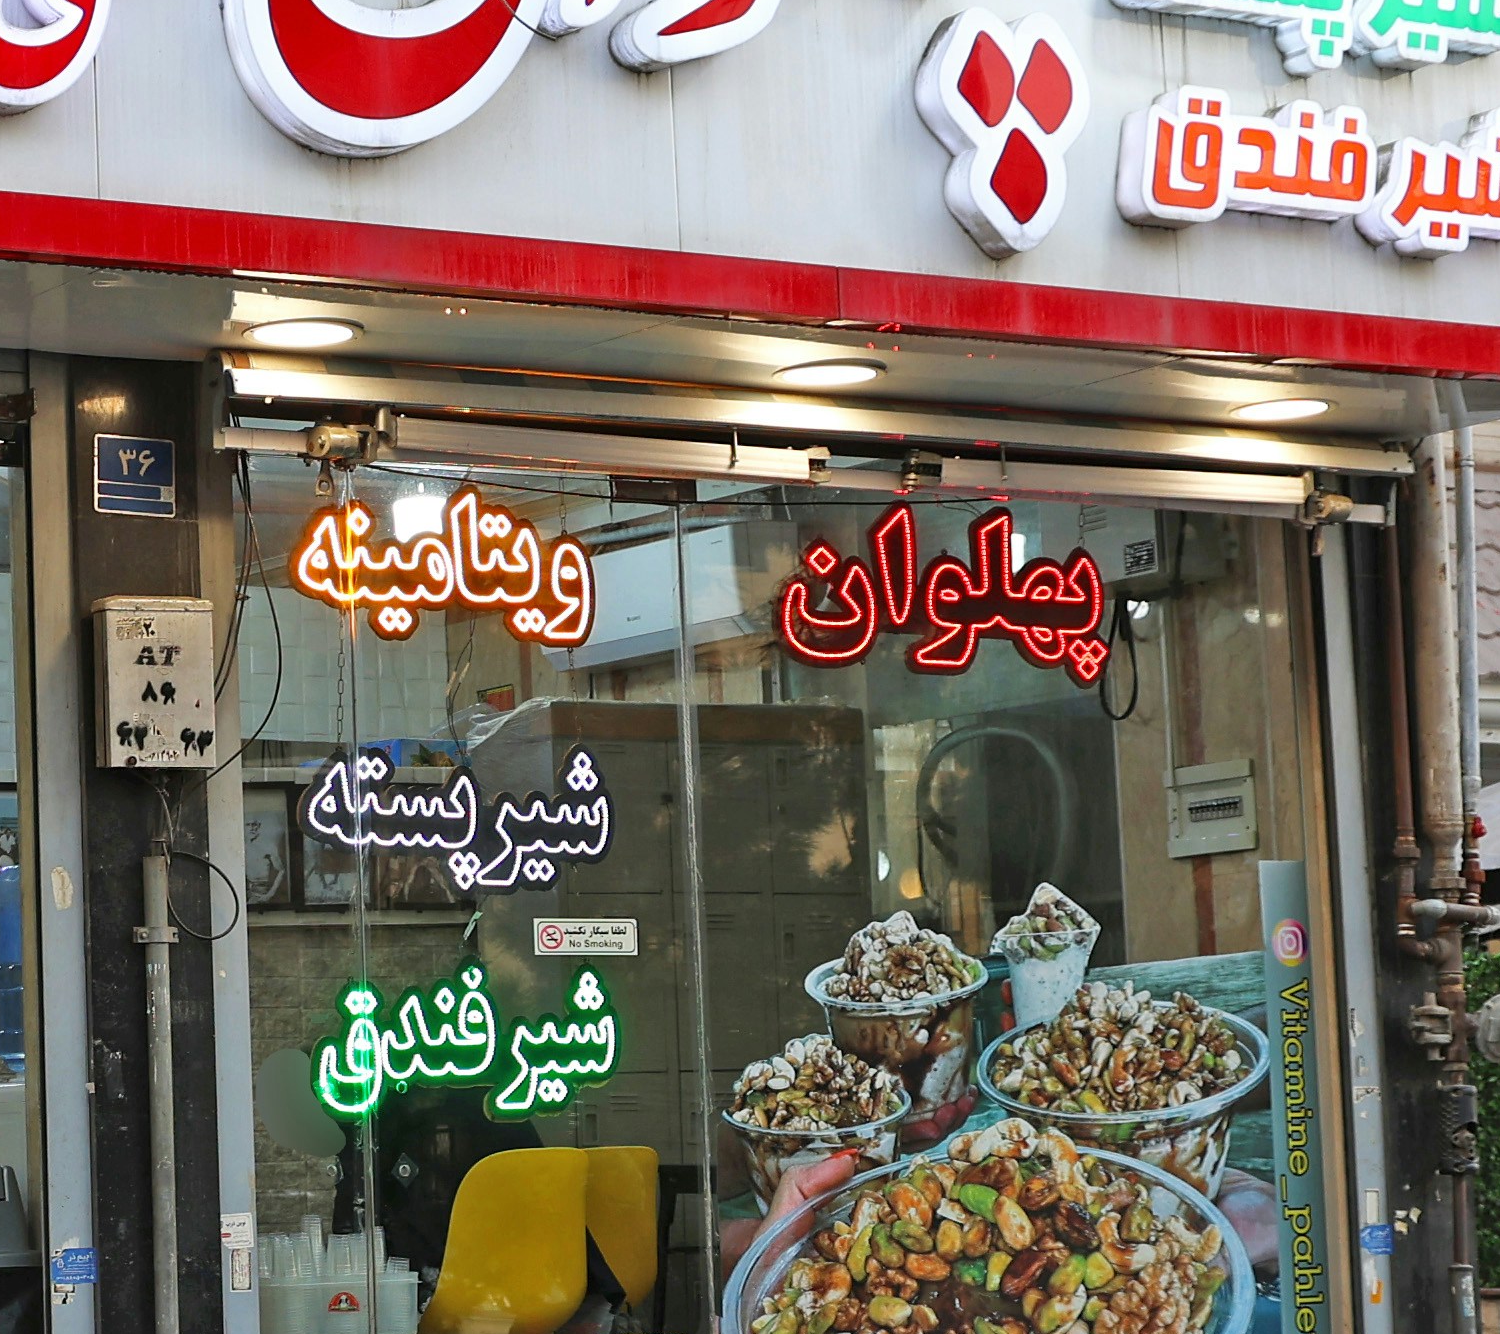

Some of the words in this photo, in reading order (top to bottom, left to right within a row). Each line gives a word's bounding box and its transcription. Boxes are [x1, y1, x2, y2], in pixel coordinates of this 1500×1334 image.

[1154, 100, 1367, 208] فندق
[117, 447, 156, 477] ۳۶
[301, 489, 590, 639] ویتامینه
[782, 507, 1107, 681] پهلوان
[308, 754, 476, 890] پسته
[477, 751, 609, 887] شیر
[569, 940, 581, 948] No
[584, 939, 623, 949] Smoking
[588, 926, 609, 938] سیگار
[611, 926, 627, 935] لطفا
[318, 967, 496, 1115] فندق
[496, 970, 616, 1113] شیر
